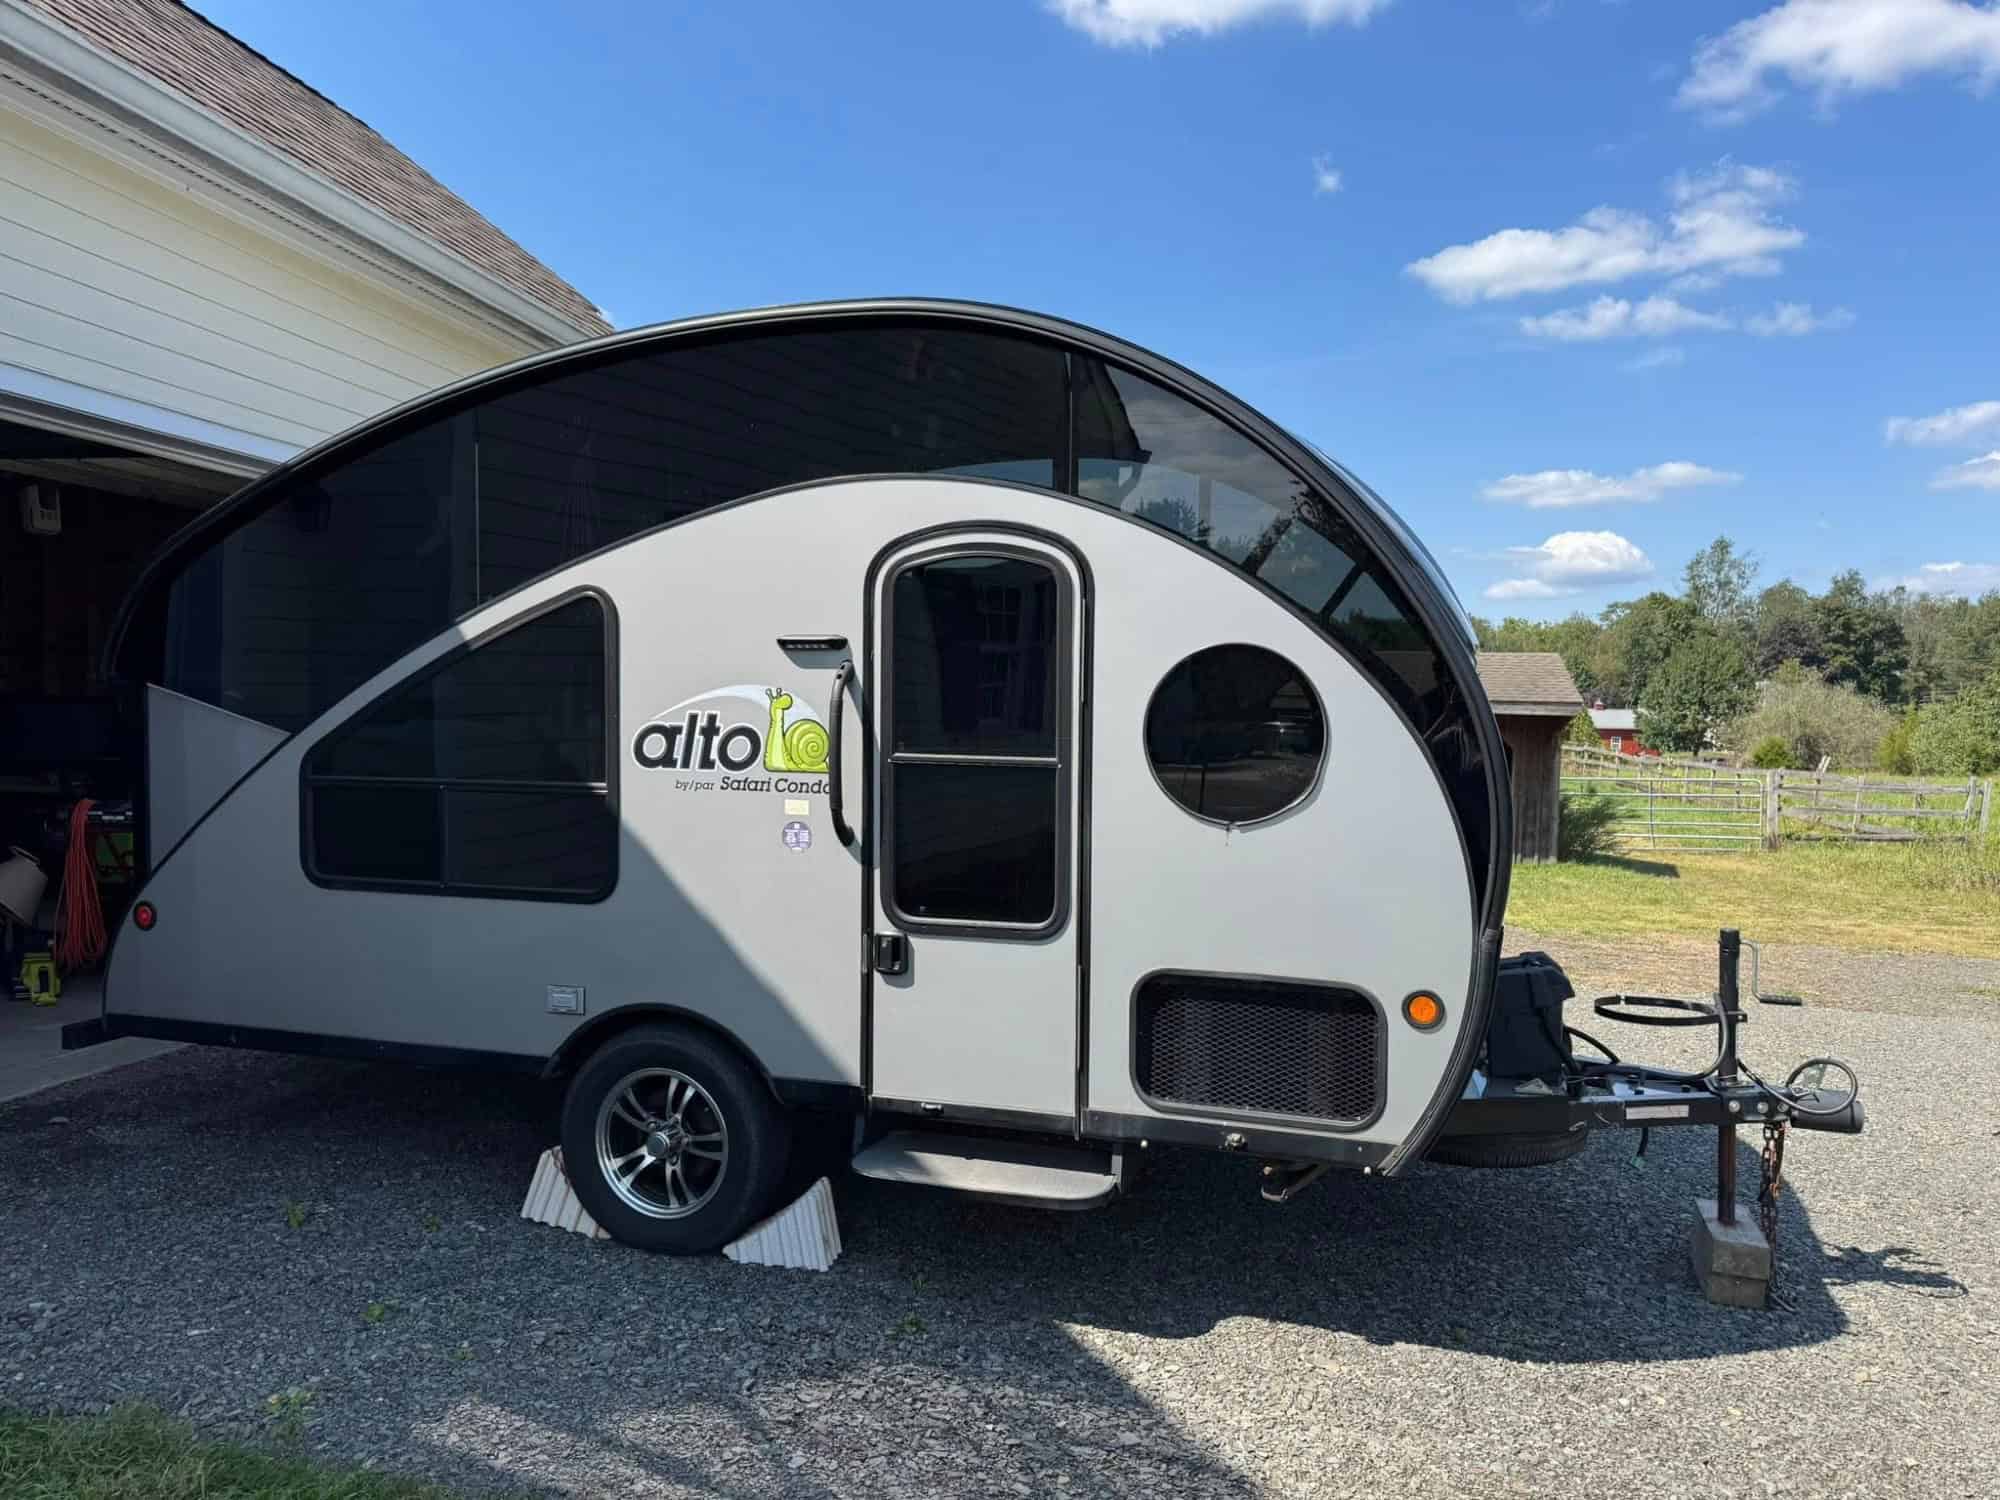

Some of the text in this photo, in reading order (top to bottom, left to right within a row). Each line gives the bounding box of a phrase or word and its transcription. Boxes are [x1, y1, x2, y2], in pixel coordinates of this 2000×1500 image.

[633, 713, 762, 771] alto
[675, 779, 714, 792] by/par
[720, 776, 771, 793] Safari
